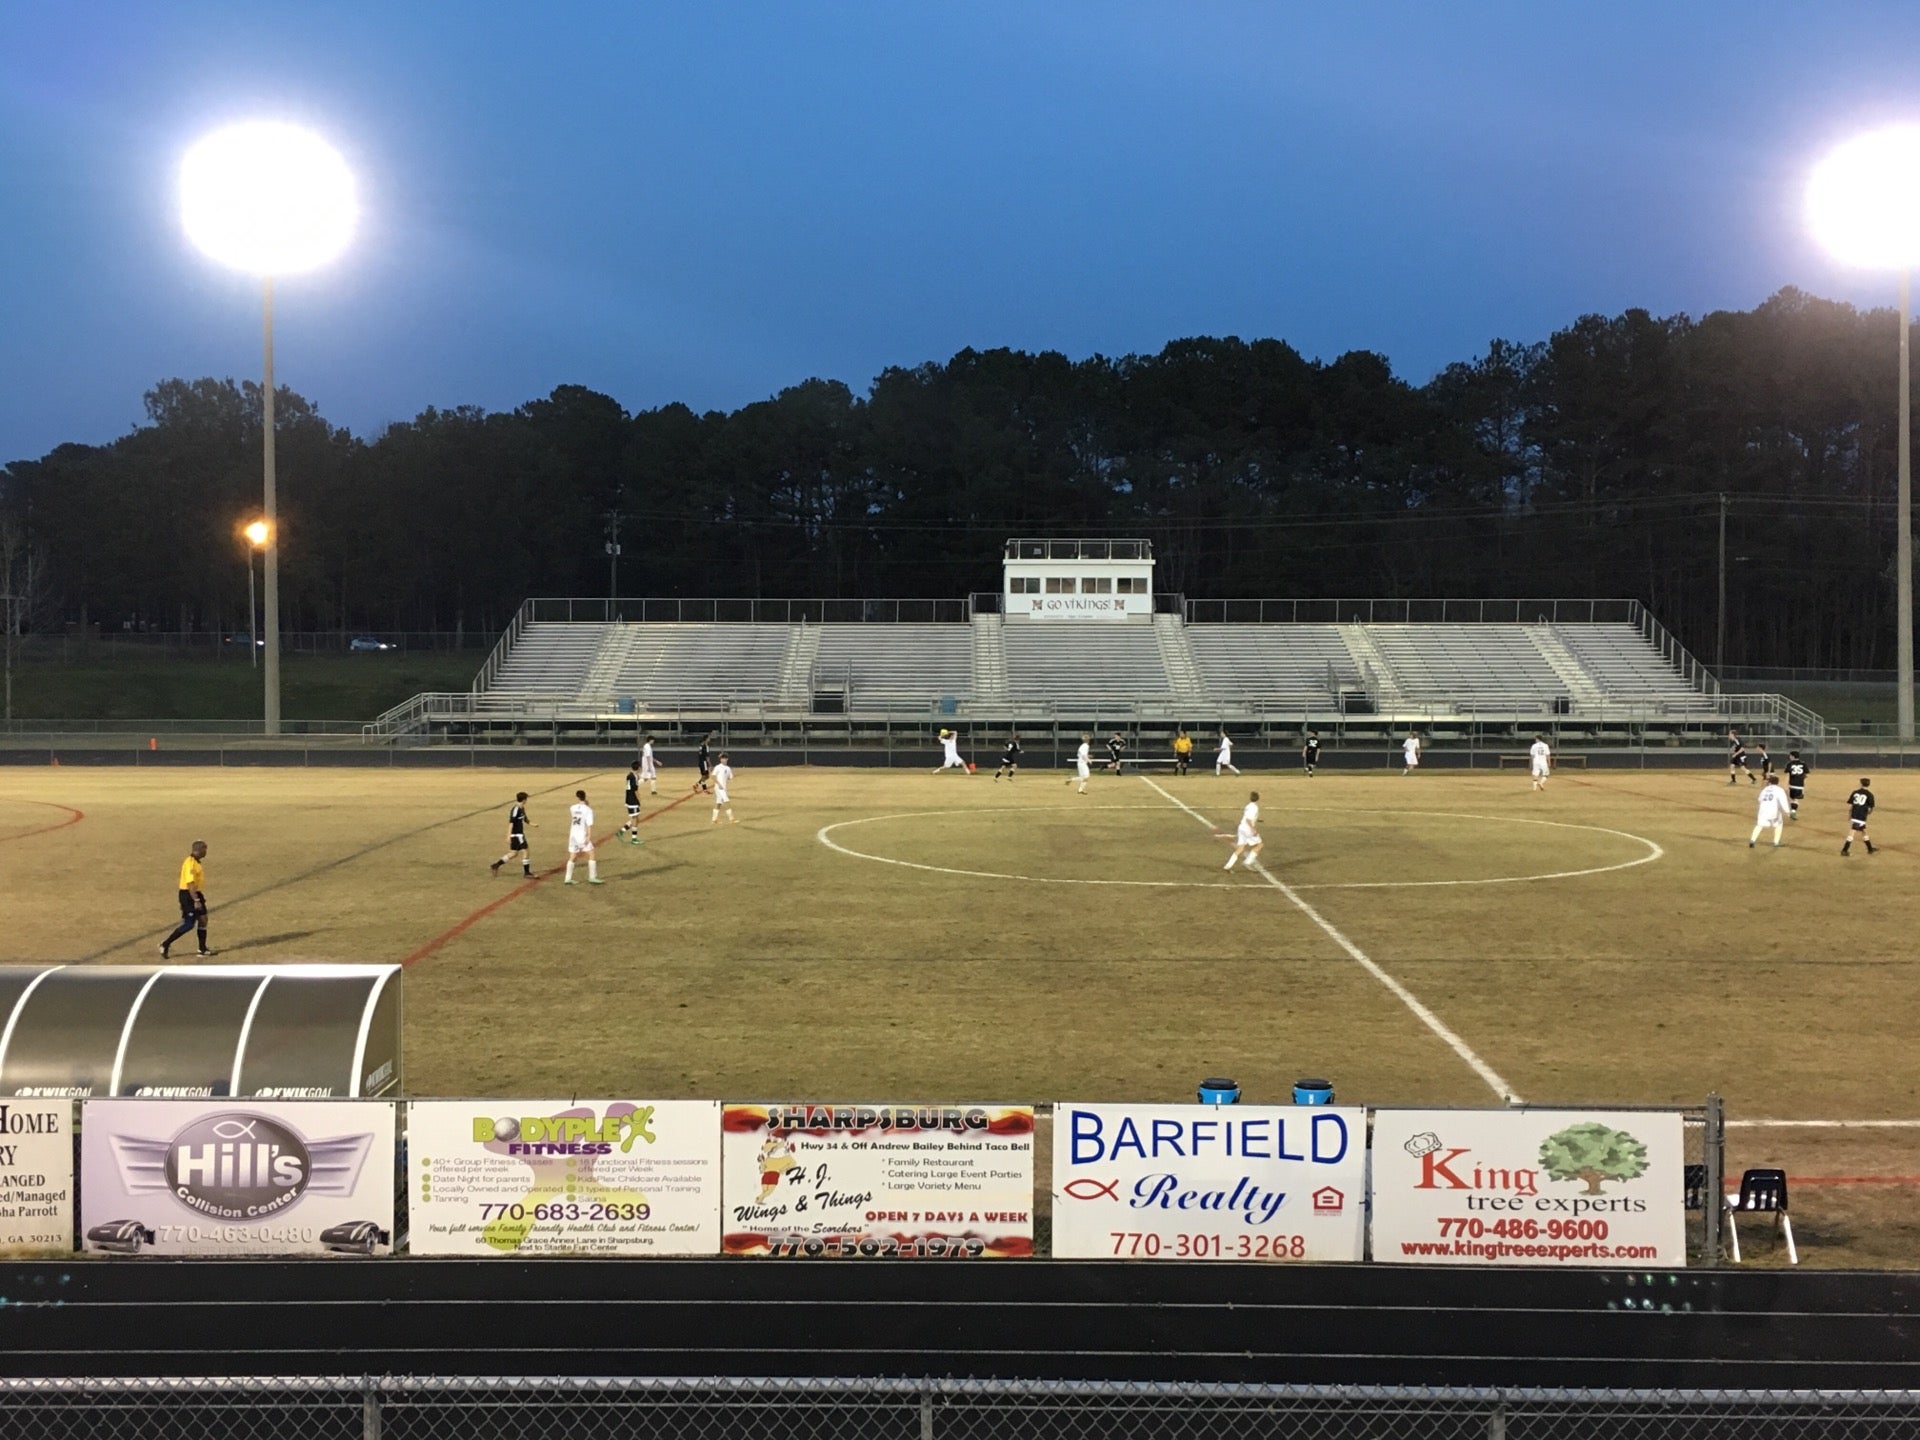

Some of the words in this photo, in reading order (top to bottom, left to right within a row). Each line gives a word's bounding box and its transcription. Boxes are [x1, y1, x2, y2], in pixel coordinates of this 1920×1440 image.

[1047, 600, 1062, 610] GO
[1790, 764, 1804, 774] 35
[1852, 793, 1867, 806] 30
[766, 1106, 989, 1130] SHARPSBURG
[1071, 1110, 1349, 1165] BARFIELD
[509, 1143, 612, 1155] FITNESS
[800, 1142, 824, 1151] Hwy
[826, 1142, 838, 1150] 34
[841, 1142, 850, 1150] &
[851, 1142, 868, 1150] Off
[870, 1142, 910, 1150] Andrew
[913, 1142, 944, 1152] Bailey
[947, 1142, 982, 1150] Behind
[985, 1142, 1008, 1150] Taco
[1011, 1142, 1030, 1151] Bell
[178, 1143, 302, 1187] Hill's
[454, 1158, 482, 1168] Group
[888, 1158, 920, 1168] Family
[923, 1158, 974, 1166] Restaurant
[888, 1170, 928, 1180] Catering
[931, 1170, 958, 1180] Large
[961, 1170, 987, 1178] Event
[990, 1170, 1022, 1179] Parties
[1413, 1148, 1539, 1196] King
[0, 1174, 45, 1187] ANGED
[458, 1175, 480, 1184] Night
[496, 1176, 530, 1184] parents
[433, 1185, 465, 1194] Locally
[520, 1185, 564, 1194] Operated
[664, 1185, 701, 1194] Training
[888, 1182, 915, 1191] Large
[918, 1182, 952, 1191] Variety
[954, 1182, 982, 1190] Menu
[177, 1186, 242, 1218] Collision
[247, 1187, 298, 1216] Center
[434, 1195, 468, 1204] Tanning
[1129, 1173, 1287, 1225] Realty
[1466, 1194, 1524, 1211] tree
[1535, 1196, 1647, 1217] experts
[0, 1206, 14, 1217] ha
[18, 1205, 58, 1216] Parrott
[479, 1204, 650, 1220] 770-683-2639
[734, 1204, 788, 1222] Wings
[795, 1195, 808, 1212] &
[815, 1190, 873, 1210] Things
[865, 1211, 908, 1221] OPEN
[913, 1212, 921, 1222] 7
[925, 1212, 964, 1222] DAYS
[969, 1212, 980, 1222] A
[984, 1212, 1028, 1222] WEEK
[159, 1225, 314, 1243] 770-463-0480
[428, 1224, 448, 1232] Your
[500, 1224, 527, 1236] Family
[530, 1224, 564, 1236] Friendly
[567, 1224, 594, 1232] Health
[597, 1223, 616, 1232] Club
[1438, 1217, 1609, 1240] 770-486-9600
[8, 1235, 24, 1243] GA
[1110, 1232, 1306, 1258] 770-301-3268
[768, 1236, 985, 1257] 770-502-1979
[1401, 1240, 1657, 1262] www.kingtreeexperts.com
